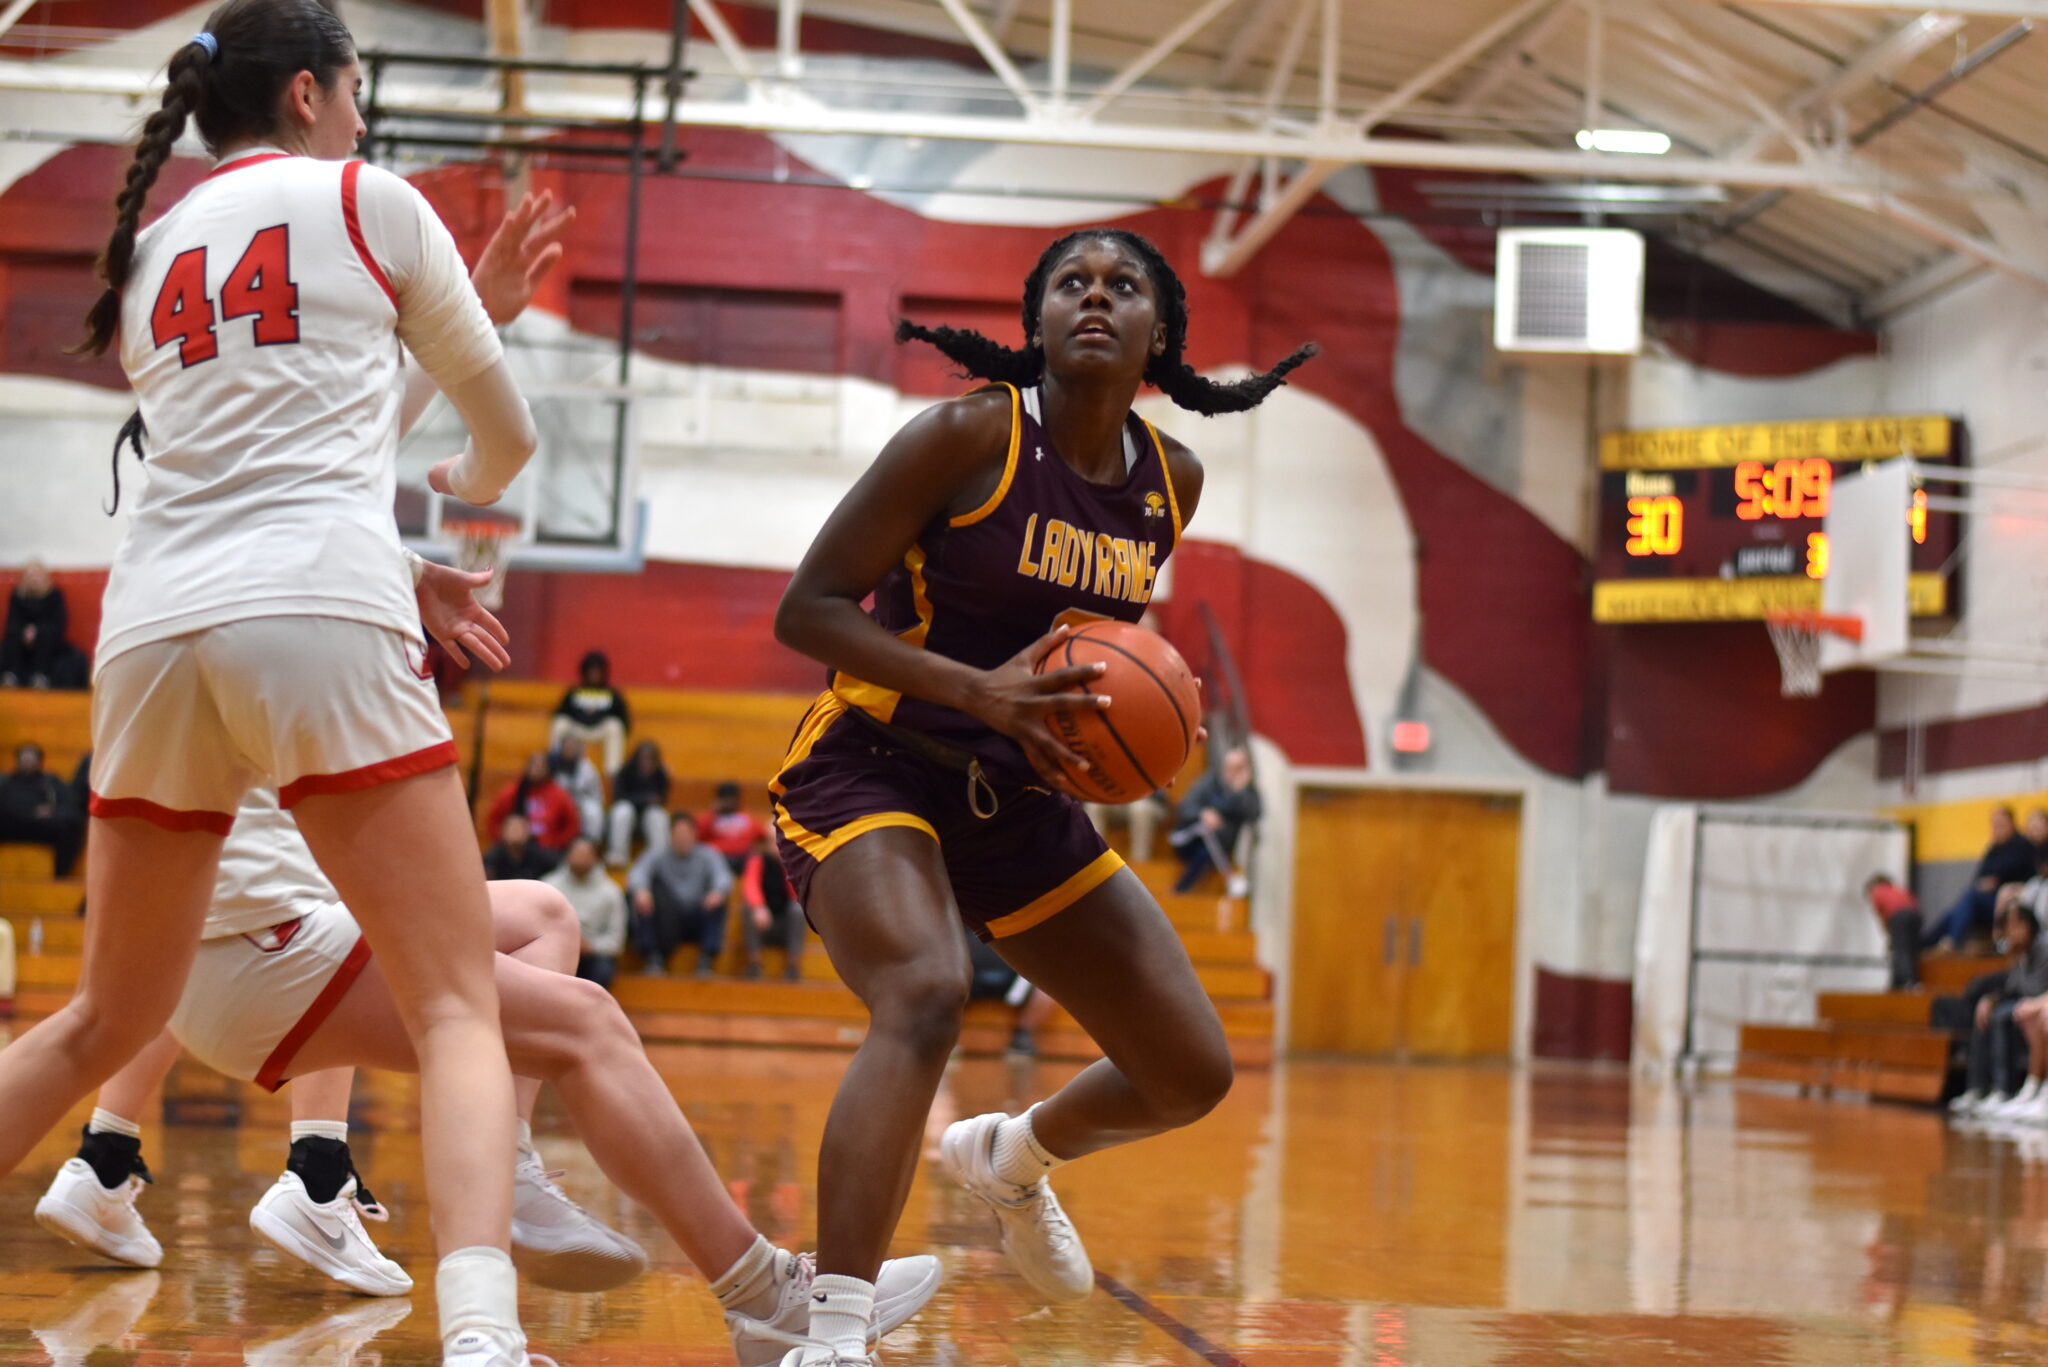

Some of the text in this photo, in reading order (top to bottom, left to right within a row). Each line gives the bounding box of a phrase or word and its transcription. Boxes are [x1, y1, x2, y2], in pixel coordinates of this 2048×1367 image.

[151, 223, 299, 369] 44
[1617, 433, 1701, 460] HOME
[1717, 429, 1752, 455] OF
[1735, 459, 1832, 520] 5:09
[1626, 497, 1683, 556] 30
